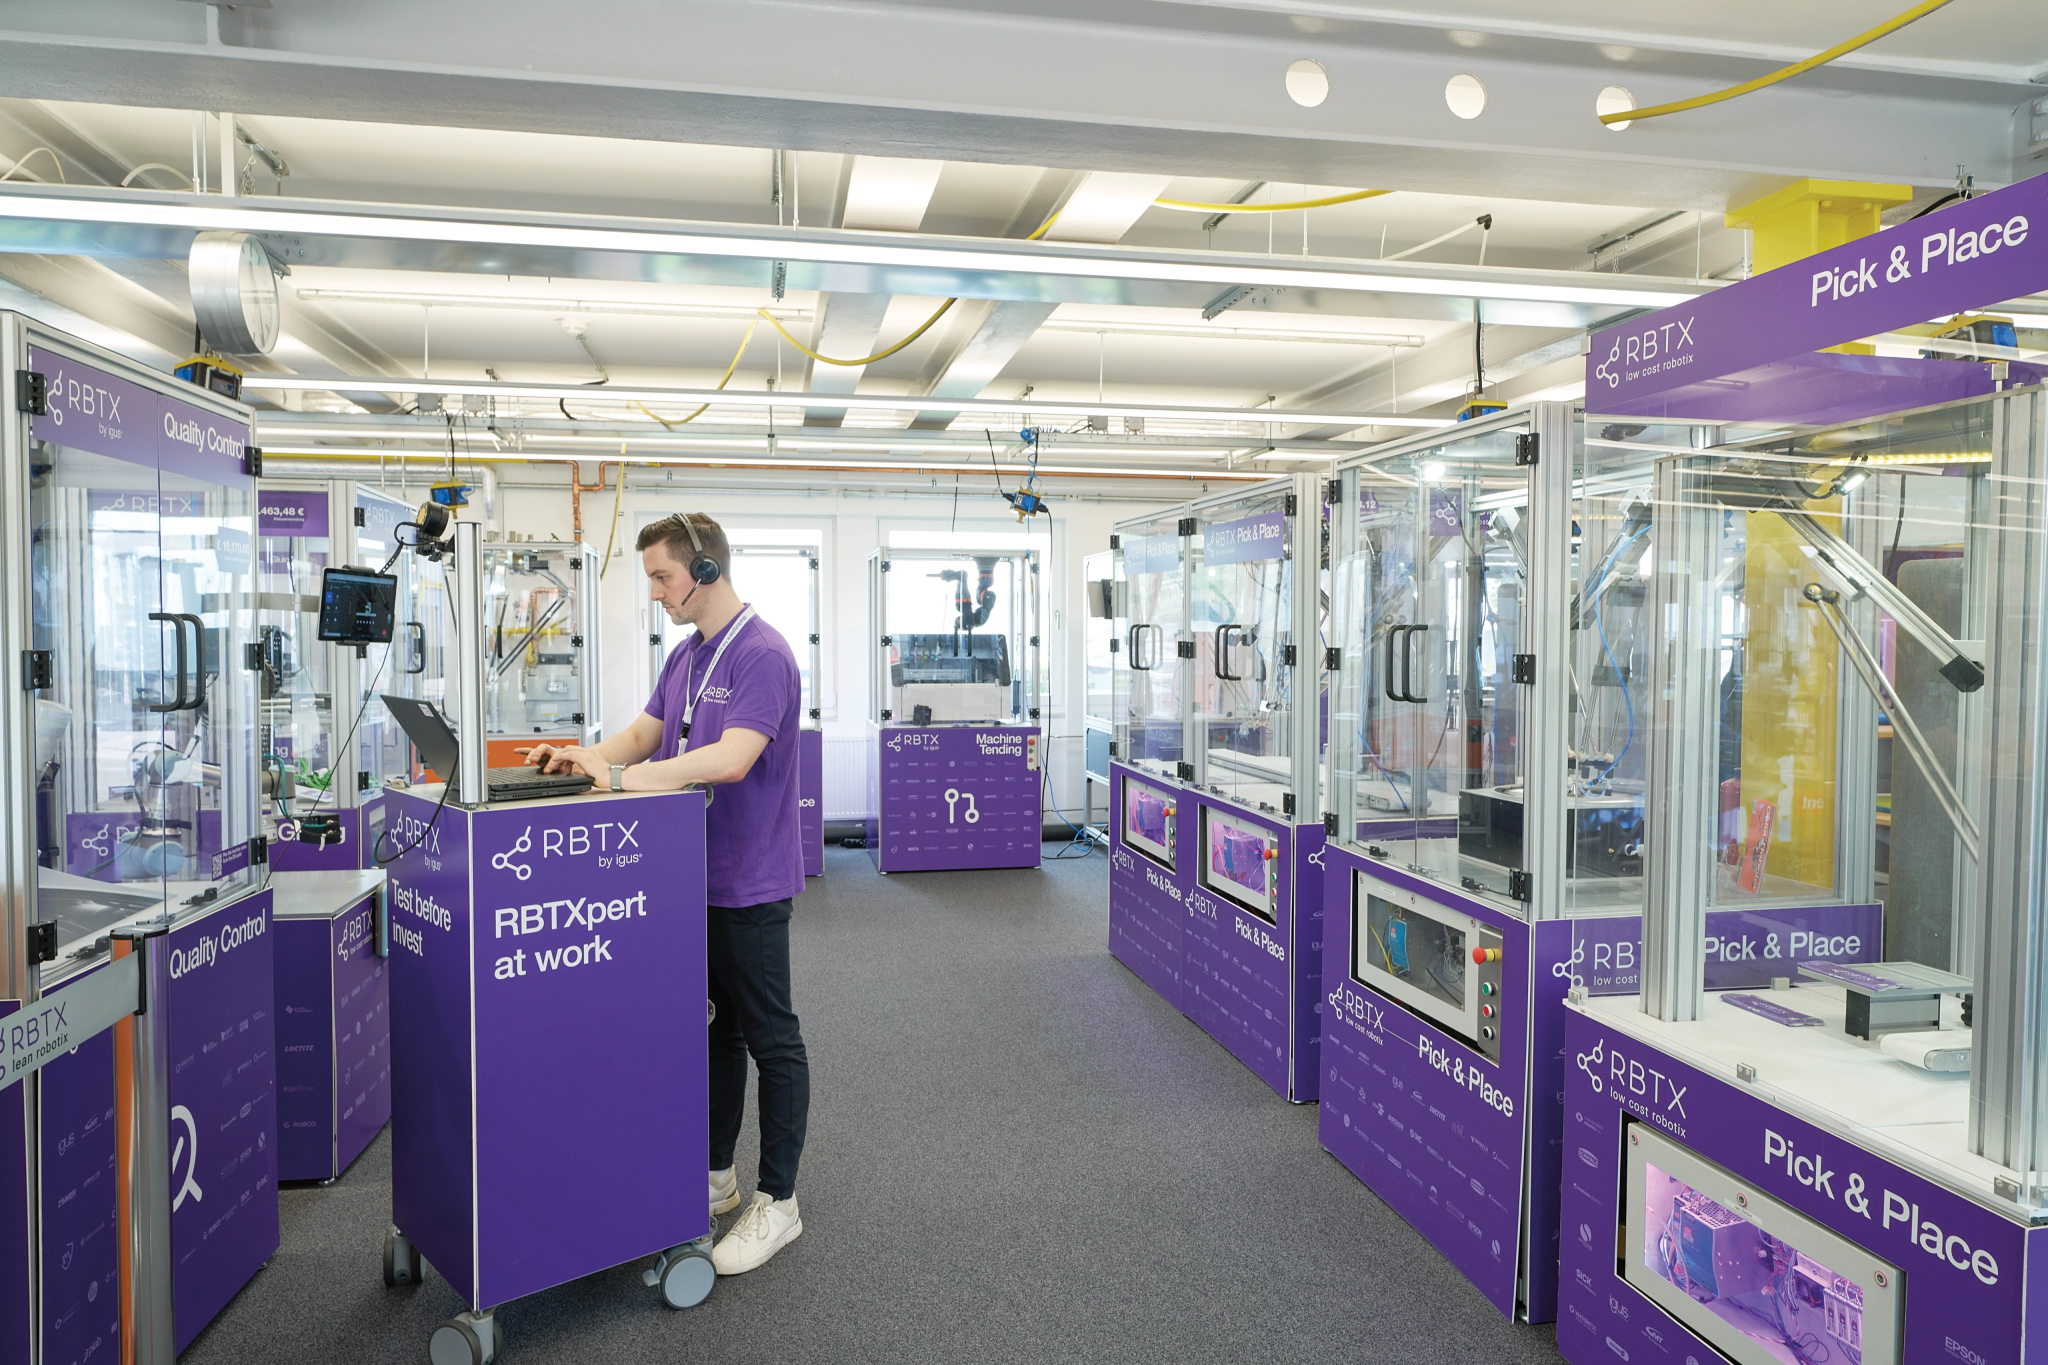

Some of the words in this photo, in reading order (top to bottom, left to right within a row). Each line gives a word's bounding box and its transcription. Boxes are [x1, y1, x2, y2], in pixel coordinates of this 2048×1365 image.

[1811, 258, 1878, 307] Pick
[1885, 245, 1911, 283] &
[1921, 215, 2029, 274] Place
[1626, 316, 1695, 366] RBTX
[1625, 366, 1640, 382] low
[1642, 362, 1660, 379] cost
[1662, 353, 1694, 372] robotix
[68, 379, 121, 424] RBTX
[98, 422, 107, 438] by
[164, 412, 205, 453] Quality
[207, 426, 245, 460] Control
[297, 508, 305, 517] €
[372, 507, 395, 524] RBTX
[1215, 529, 1236, 547] RBTX
[1237, 527, 1252, 543] Pick
[1252, 525, 1258, 541] &
[1259, 523, 1280, 539] Place
[710, 687, 732, 701] RBTX
[904, 734, 939, 746] RBTX
[976, 733, 1022, 745] Machine
[979, 744, 1022, 757] Tending
[405, 816, 441, 856] RBTX
[543, 820, 639, 858] RBTX
[424, 854, 431, 868] by
[598, 856, 613, 869] by
[1119, 850, 1135, 872] RBTX
[1146, 867, 1159, 888] Pick
[1159, 875, 1164, 891] &
[1165, 878, 1182, 902] Place
[392, 878, 413, 914] Test
[415, 888, 452, 932] before
[495, 890, 647, 939] RBTXpert
[1195, 893, 1218, 921] RBTX
[350, 906, 373, 943] RBTX
[392, 916, 423, 957] invest
[1235, 916, 1252, 942] Pick
[1253, 926, 1260, 947] &
[1262, 931, 1285, 962] Place
[169, 937, 218, 980] Quality
[220, 908, 266, 953] Control
[494, 948, 526, 980] at
[534, 935, 613, 972] work
[1704, 934, 1757, 964] Pick
[1763, 934, 1782, 959] &
[1789, 931, 1861, 958] Place
[1593, 975, 1611, 986] low
[1614, 974, 1638, 986] cost
[11, 1001, 67, 1056] RBTX
[1345, 989, 1385, 1034] RBTX
[284, 1044, 314, 1052] LOCTITE
[1345, 1014, 1354, 1027] low
[1354, 1020, 1365, 1035] cost
[1365, 1027, 1384, 1047] robotix
[12, 1053, 33, 1072] lean
[36, 1033, 68, 1059] robotix
[1418, 1034, 1450, 1077] Pick
[1453, 1057, 1465, 1087] &
[1468, 1065, 1514, 1118] Place
[1610, 1049, 1688, 1120] RBTX
[1609, 1086, 1626, 1104] low
[1628, 1097, 1649, 1118] cost
[1652, 1110, 1687, 1139] robotix
[1764, 1128, 1835, 1202] Pick
[1844, 1172, 1872, 1221] &
[1881, 1188, 1999, 1286] Place
[1576, 1268, 1592, 1287] SICK
[1609, 1293, 1629, 1319] igus
[1945, 1335, 1986, 1365] EPSON
